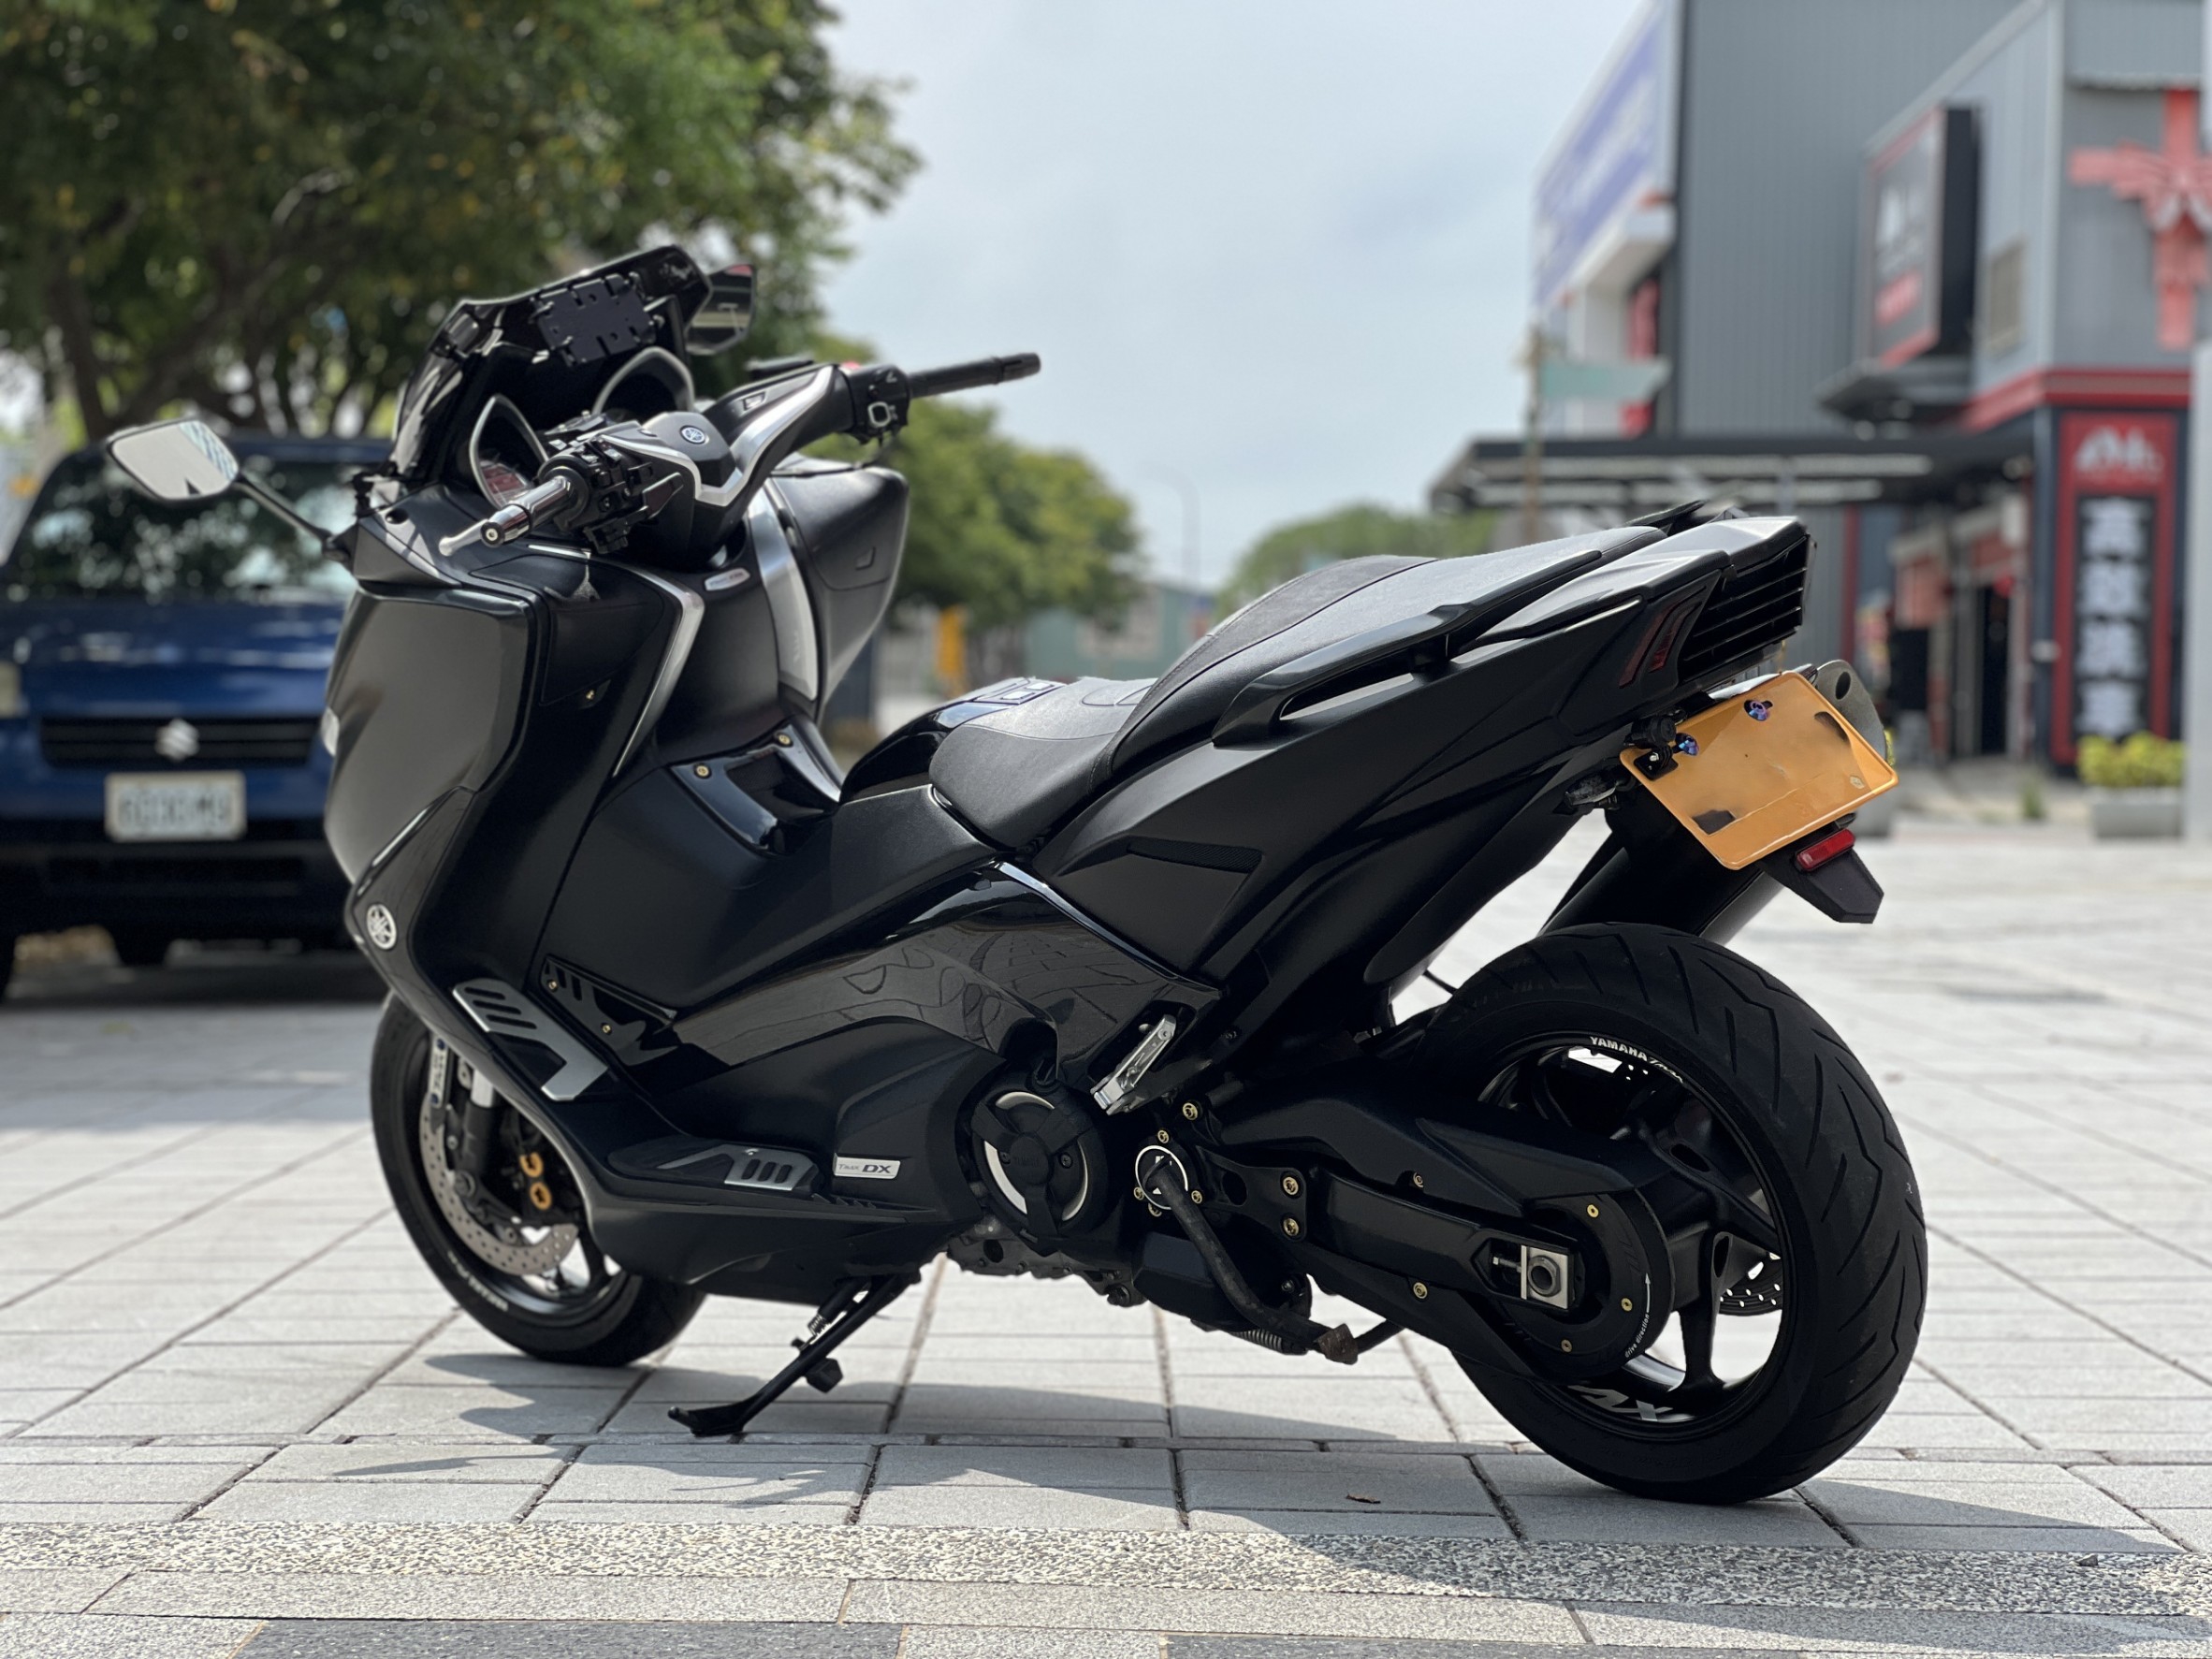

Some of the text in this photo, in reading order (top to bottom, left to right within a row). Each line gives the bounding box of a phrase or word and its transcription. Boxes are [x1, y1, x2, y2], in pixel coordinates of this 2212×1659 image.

[1590, 1036, 1648, 1062] YAMAHA
[862, 1164, 891, 1173] DX
[1624, 1313, 1650, 1358] drive direction
